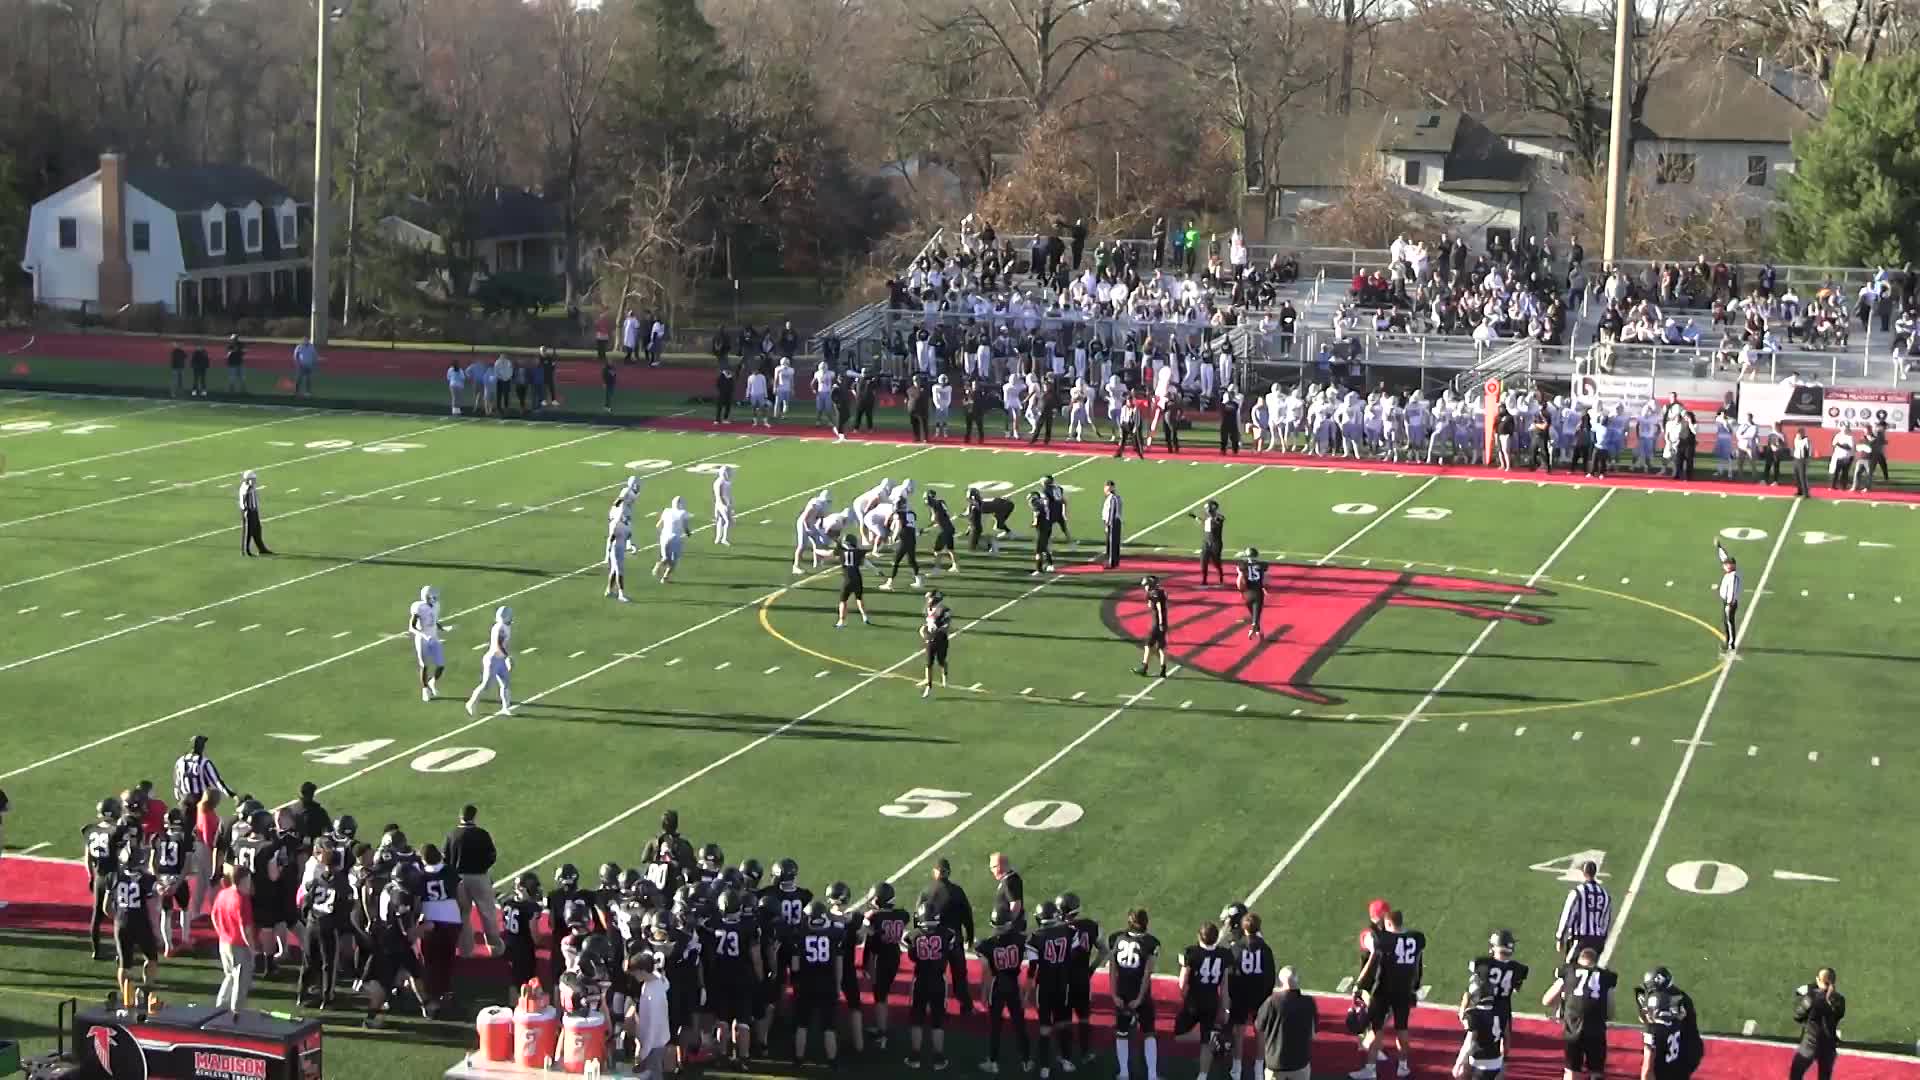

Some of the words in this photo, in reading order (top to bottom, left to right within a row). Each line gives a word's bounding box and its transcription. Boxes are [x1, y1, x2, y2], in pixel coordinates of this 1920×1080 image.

[160, 841, 179, 867] 13
[116, 882, 141, 908] 82
[426, 879, 448, 901] 51
[781, 899, 802, 925] 93
[715, 929, 739, 957] 73
[804, 935, 829, 962] 58
[917, 935, 942, 960] 62
[1043, 937, 1066, 964] 47
[1116, 940, 1141, 968] 26
[1394, 937, 1417, 964] 42
[1200, 957, 1222, 984] 44
[1573, 968, 1600, 998] 74
[194, 1052, 267, 1078] MADISON
